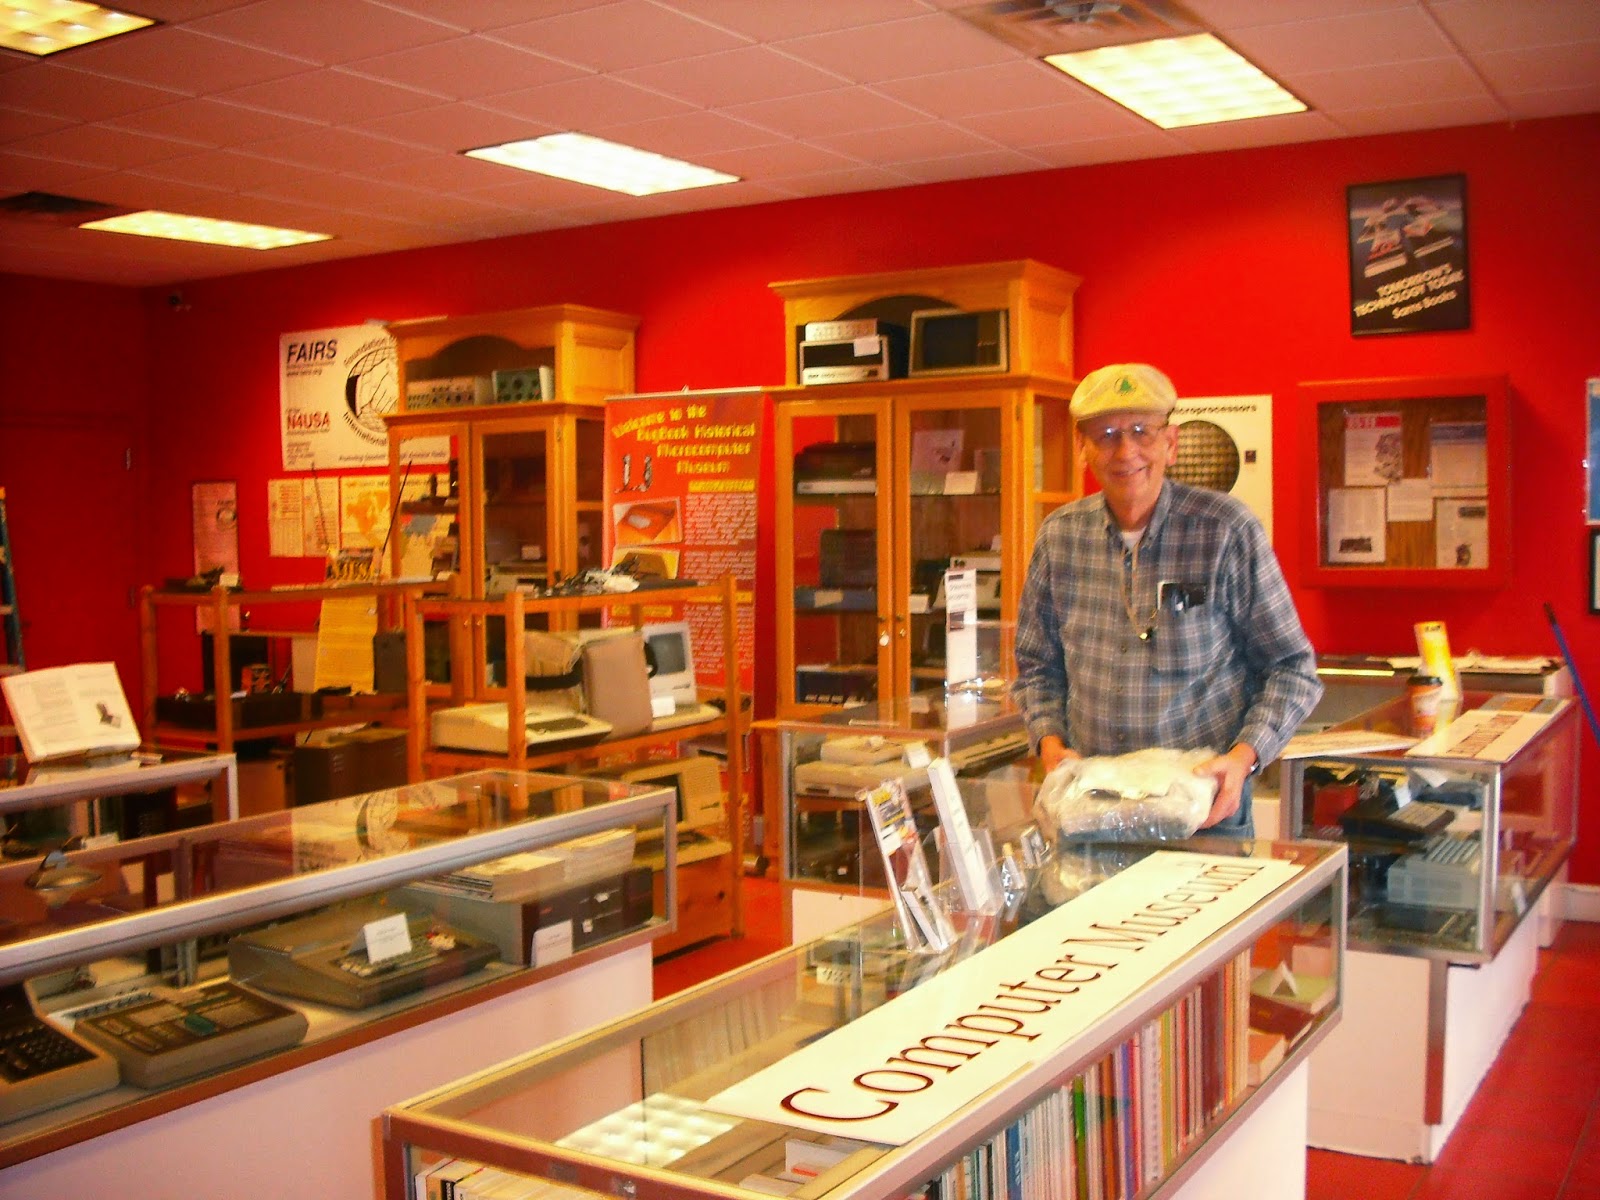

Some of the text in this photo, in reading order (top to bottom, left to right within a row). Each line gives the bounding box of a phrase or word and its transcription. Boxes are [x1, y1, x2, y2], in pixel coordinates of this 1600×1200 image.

[1353, 269, 1465, 317] TECHNOLOGY TODAY
[286, 339, 338, 363] FAIRS
[286, 410, 331, 430] N4USA
[669, 407, 682, 420] to
[687, 403, 707, 418] the
[694, 422, 756, 439] Historical
[780, 864, 1264, 1122] Computer Museum
